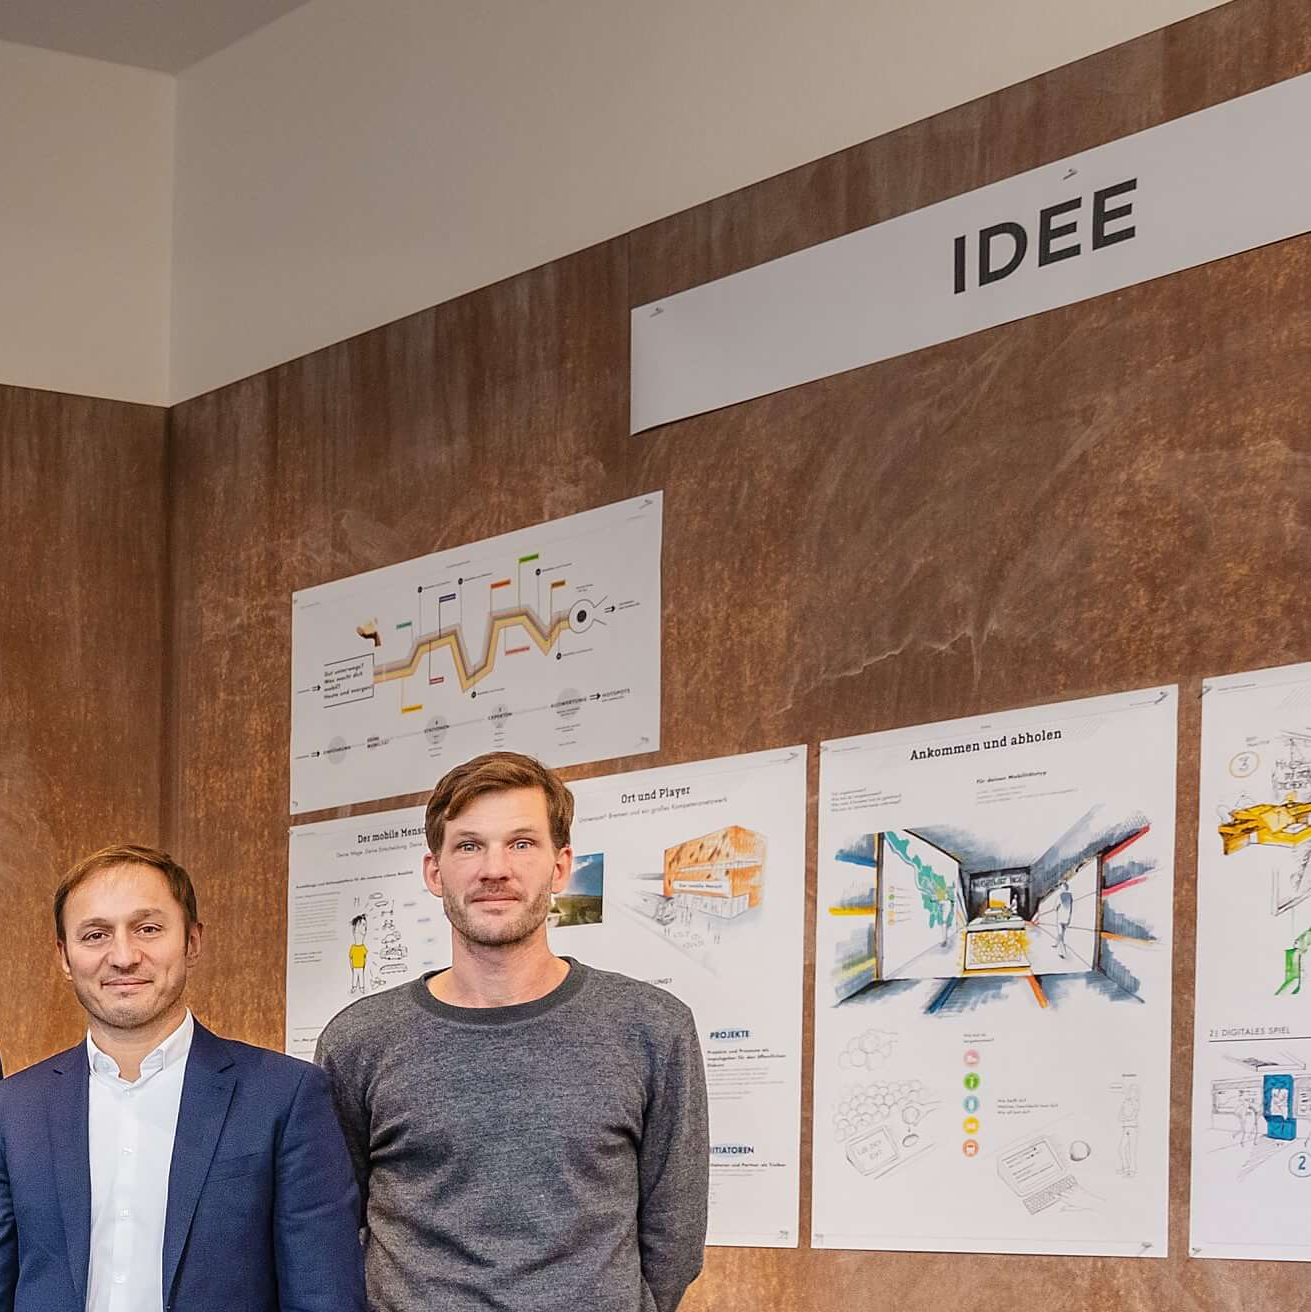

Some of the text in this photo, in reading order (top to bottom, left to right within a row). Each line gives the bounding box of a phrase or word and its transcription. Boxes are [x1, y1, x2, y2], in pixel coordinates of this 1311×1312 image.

[953, 177, 1138, 295] IDEE
[910, 728, 1062, 761] Ankommen und abholen
[621, 785, 691, 804] Ort und Player
[357, 834, 371, 844] Der
[372, 830, 399, 842] mobile
[709, 1030, 750, 1040] PROJEKTE
[1221, 1027, 1266, 1038] DIGITALES
[1268, 1025, 1291, 1036] SPIEL
[1297, 1155, 1307, 1170] 2
